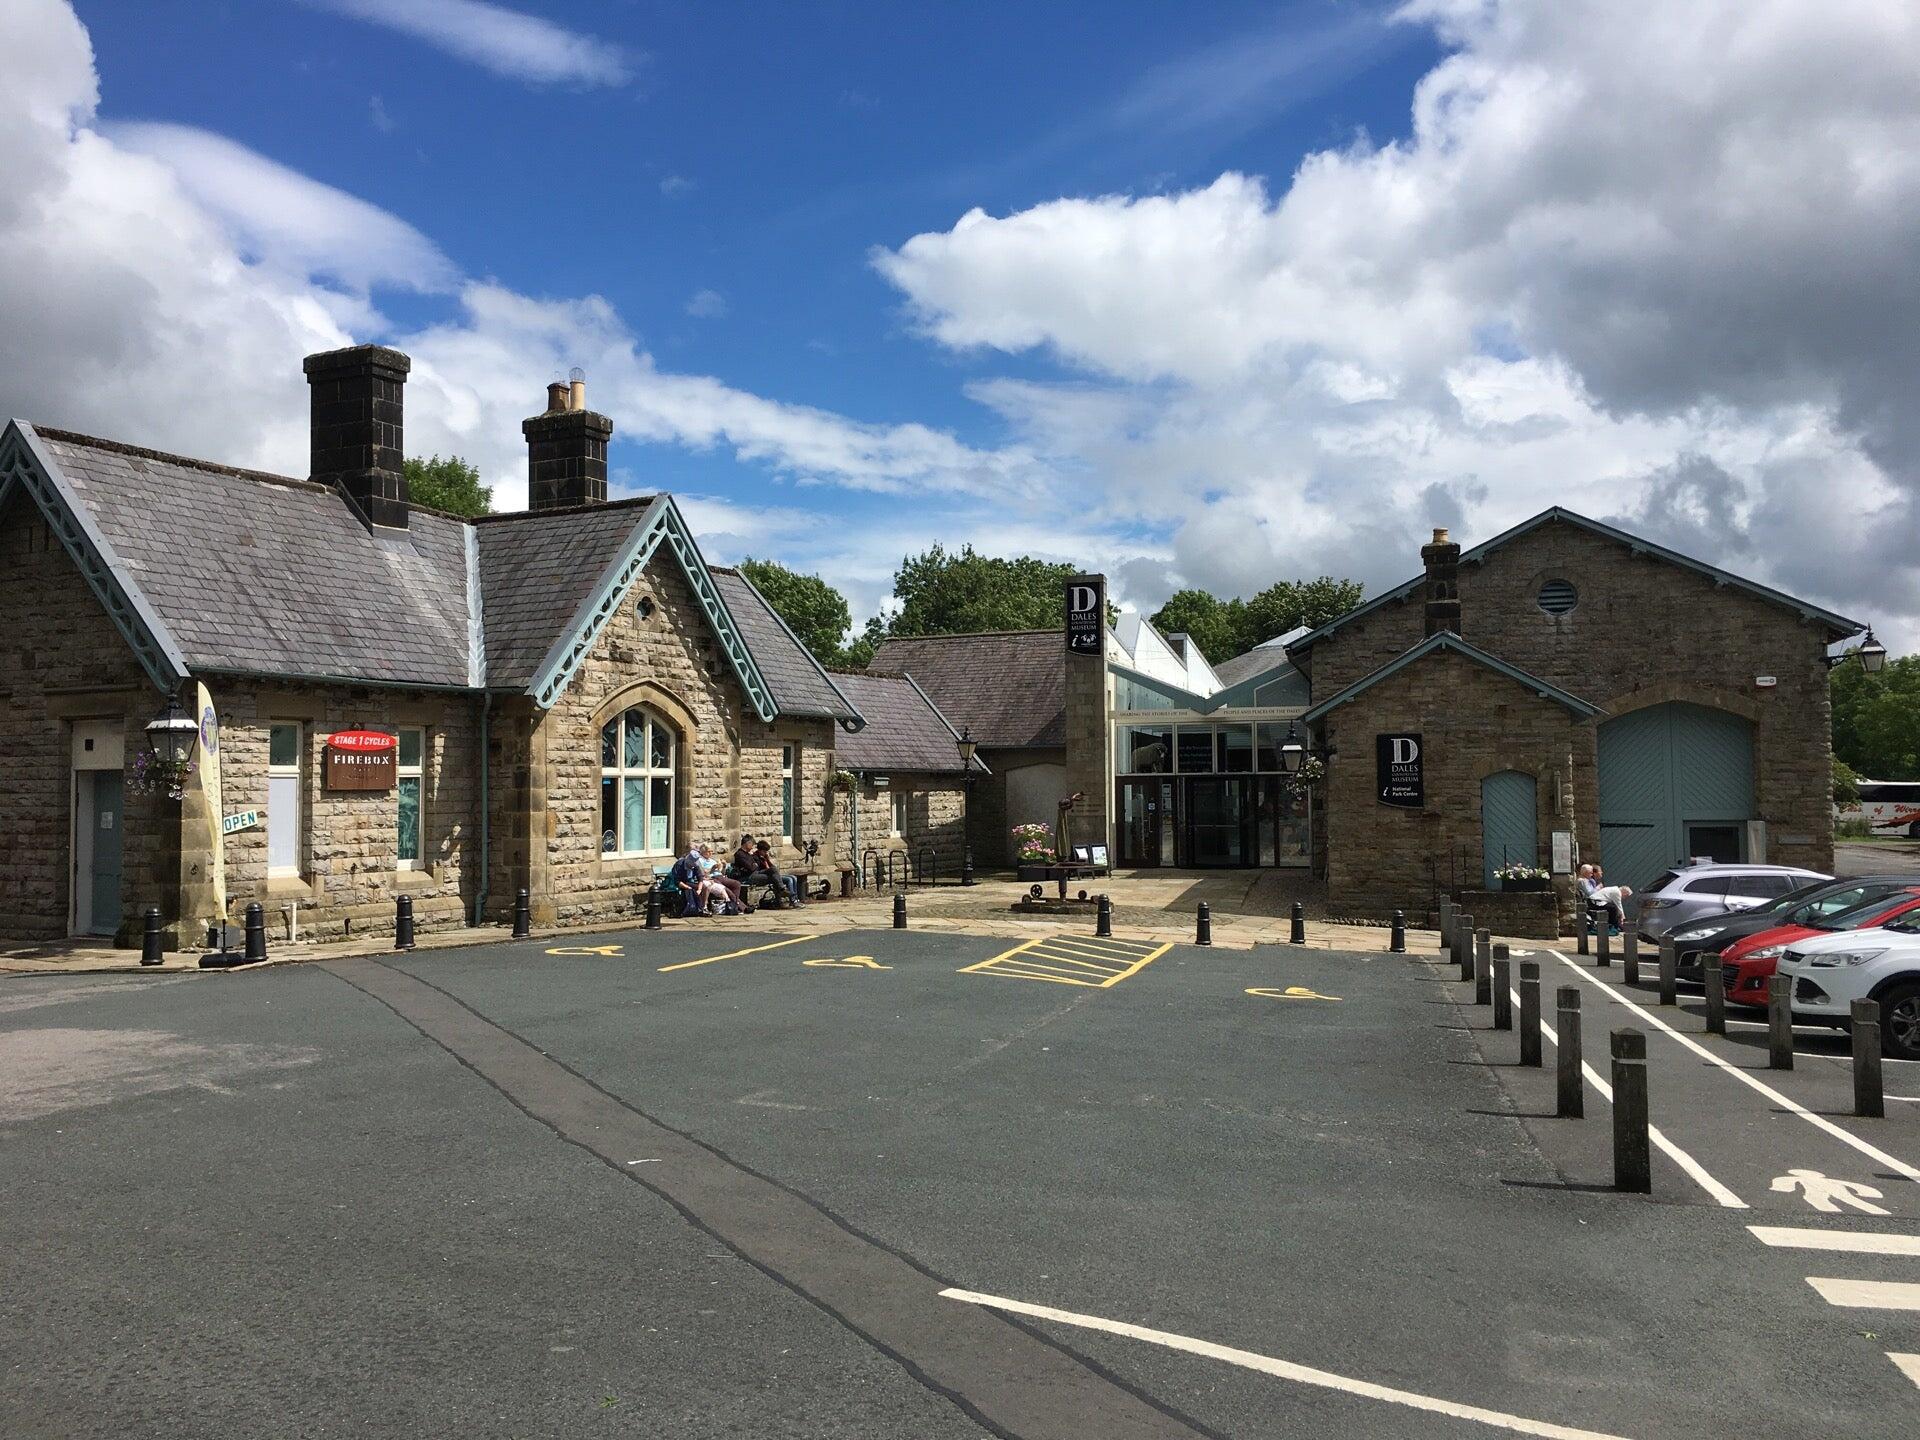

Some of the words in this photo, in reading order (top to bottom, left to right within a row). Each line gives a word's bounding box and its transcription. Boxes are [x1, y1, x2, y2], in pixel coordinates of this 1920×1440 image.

[1070, 586, 1096, 612] D
[334, 735, 358, 745] STAGE
[359, 735, 364, 746] 1
[364, 736, 390, 746] CYCLES
[334, 755, 390, 765] FIREBOX
[1391, 738, 1418, 764] D
[224, 811, 255, 831] OPEN
